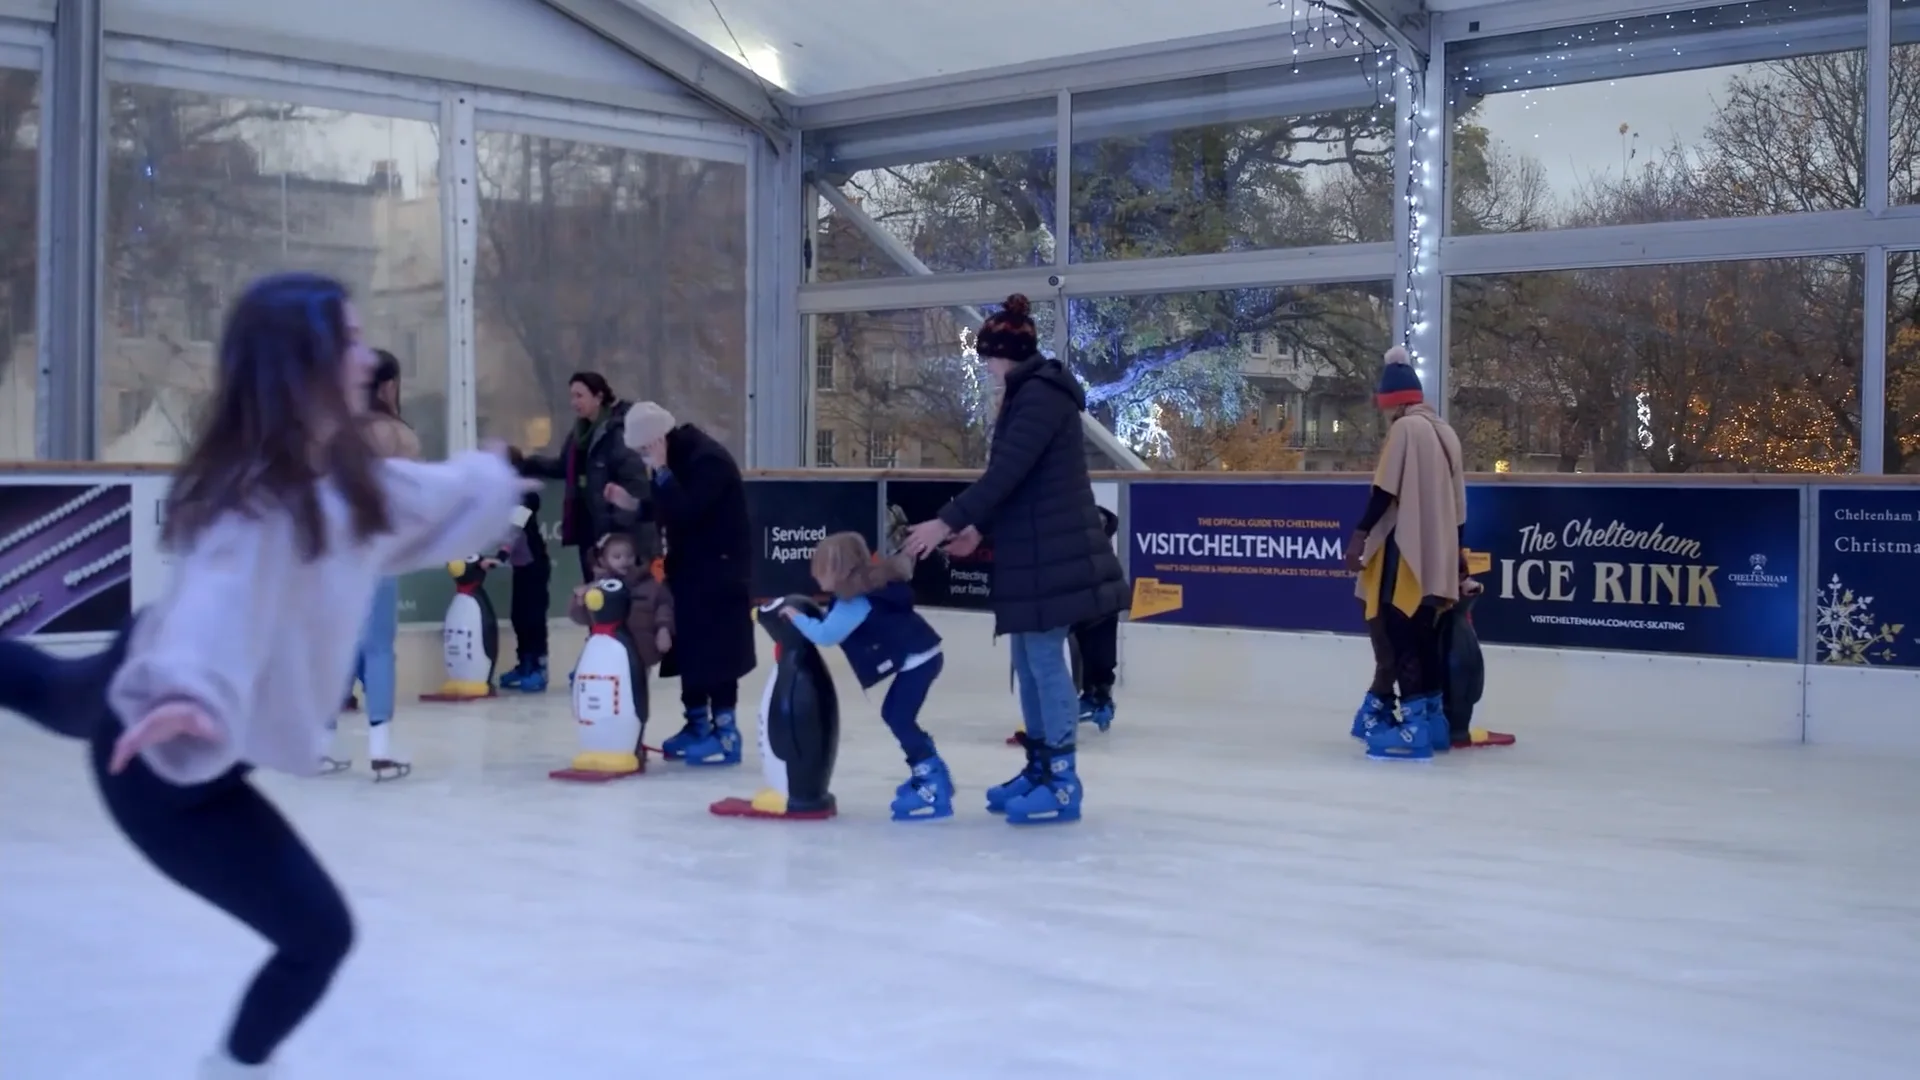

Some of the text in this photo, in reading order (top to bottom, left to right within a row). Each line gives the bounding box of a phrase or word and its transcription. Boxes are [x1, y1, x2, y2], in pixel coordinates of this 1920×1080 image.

[1834, 508, 1912, 521] Cheltenham
[1197, 517, 1340, 529] THE OFFICIAL GUIDE TO CHELTENHAM
[771, 525, 826, 542] Serviced
[1518, 517, 1701, 559] The Cheltenham
[1136, 532, 1347, 560] VISITCHELTENHAM.
[1834, 536, 1920, 554] Christma
[950, 569, 988, 583] Protecting
[1273, 567, 1298, 576] PLACES
[1299, 568, 1309, 576] TO
[1727, 573, 1788, 583] CHELTENHAM
[949, 583, 991, 597] your family
[1499, 559, 1721, 608] ICE RINK
[1530, 614, 1685, 631] VISITCHELTENHAM.COM/ICE-SKATING
